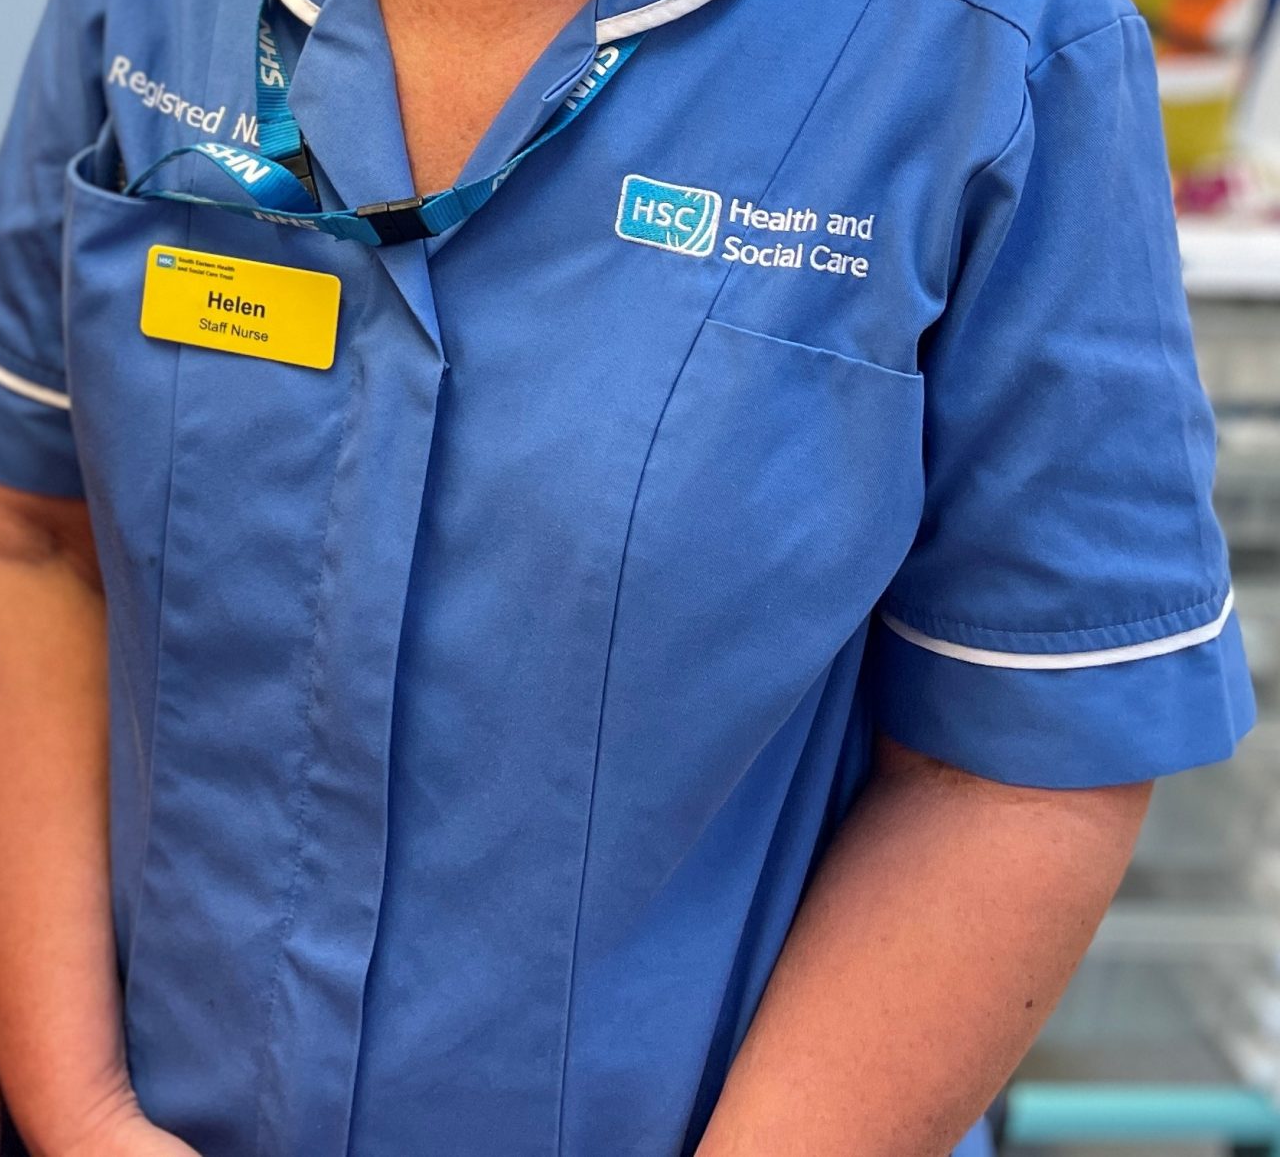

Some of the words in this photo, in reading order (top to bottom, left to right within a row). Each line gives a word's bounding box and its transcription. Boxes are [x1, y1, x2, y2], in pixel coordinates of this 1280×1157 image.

[259, 18, 284, 89] NHS
[198, 142, 271, 184] NHS
[632, 196, 696, 232] HSC
[728, 198, 817, 232] Health
[826, 212, 874, 240] and
[721, 236, 803, 268] Social
[810, 245, 869, 278] Care
[207, 291, 266, 318] Helen
[199, 317, 227, 334] Staff
[231, 324, 269, 342] Nurse
